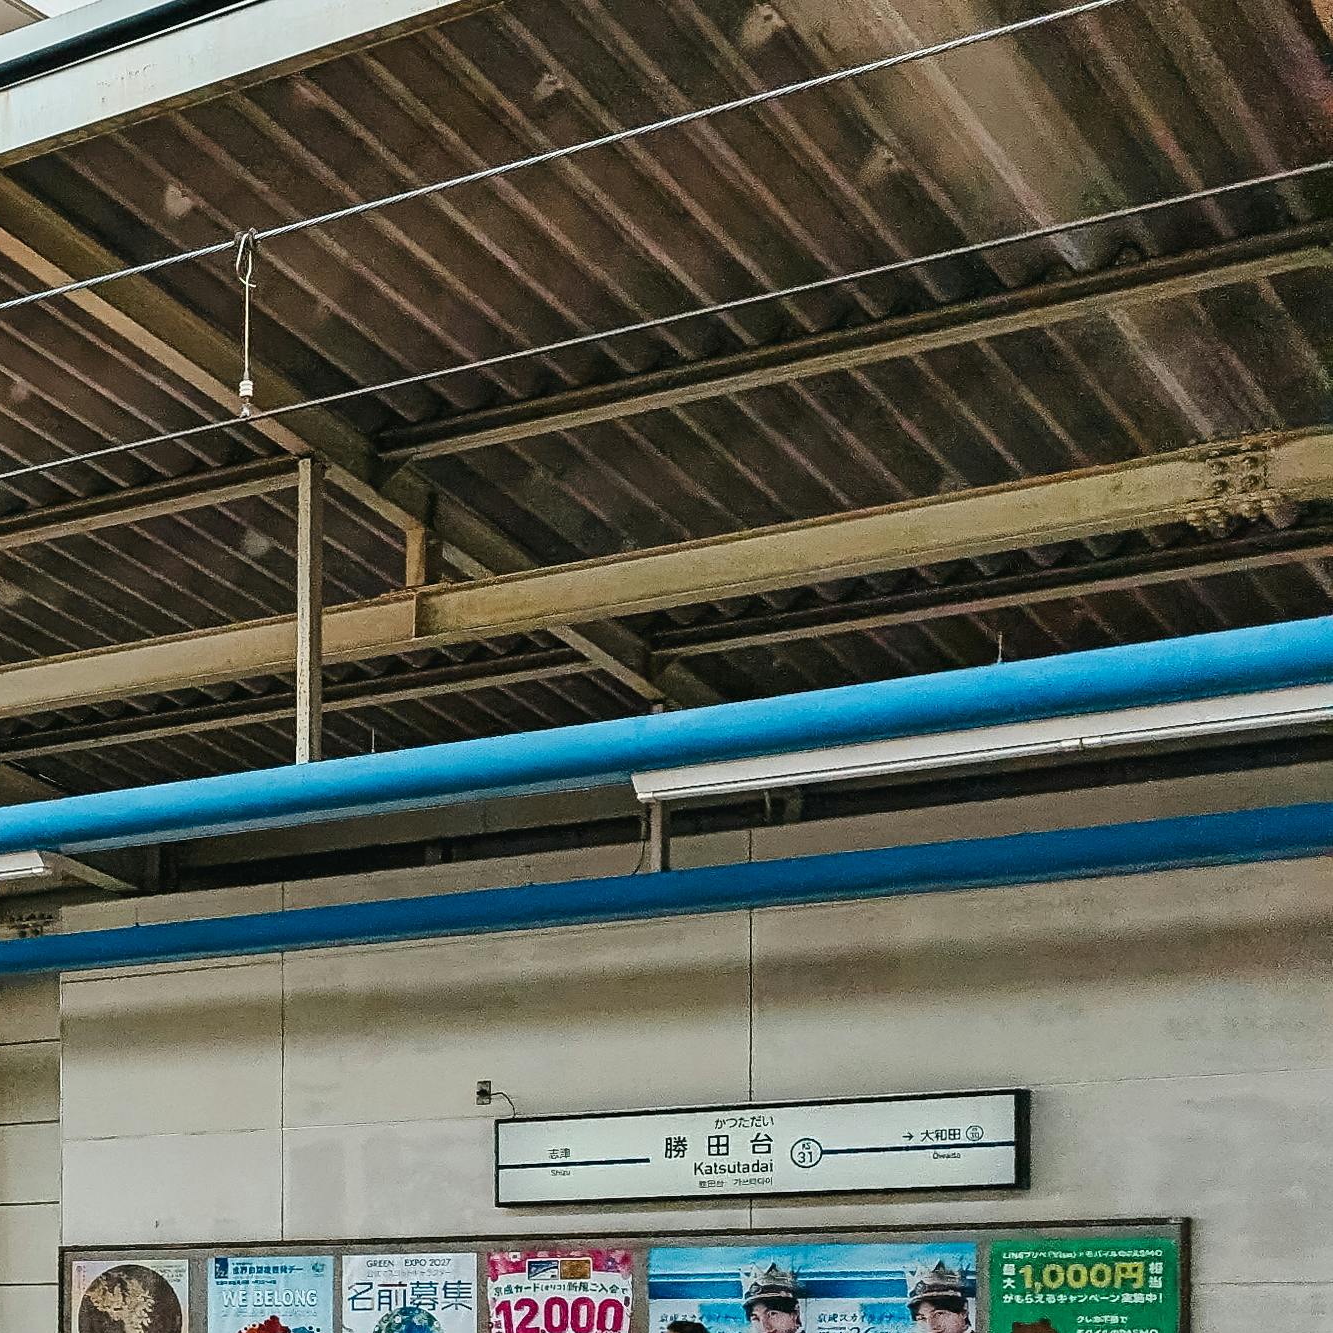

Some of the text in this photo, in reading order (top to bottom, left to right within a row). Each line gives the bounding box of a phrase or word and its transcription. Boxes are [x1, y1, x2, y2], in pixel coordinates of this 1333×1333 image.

[714, 1115, 775, 1130] かつただい
[920, 1128, 961, 1142] 大和田
[664, 1132, 774, 1159] 勝田台
[797, 1151, 814, 1164] 31
[693, 1159, 774, 1176] Katsutadai
[404, 1258, 426, 1267] EXPO
[428, 1258, 452, 1267] 2027
[1019, 1261, 1145, 1293] 1,000円
[222, 1288, 318, 1307] WE BELONG
[347, 1280, 473, 1312] 名前募集
